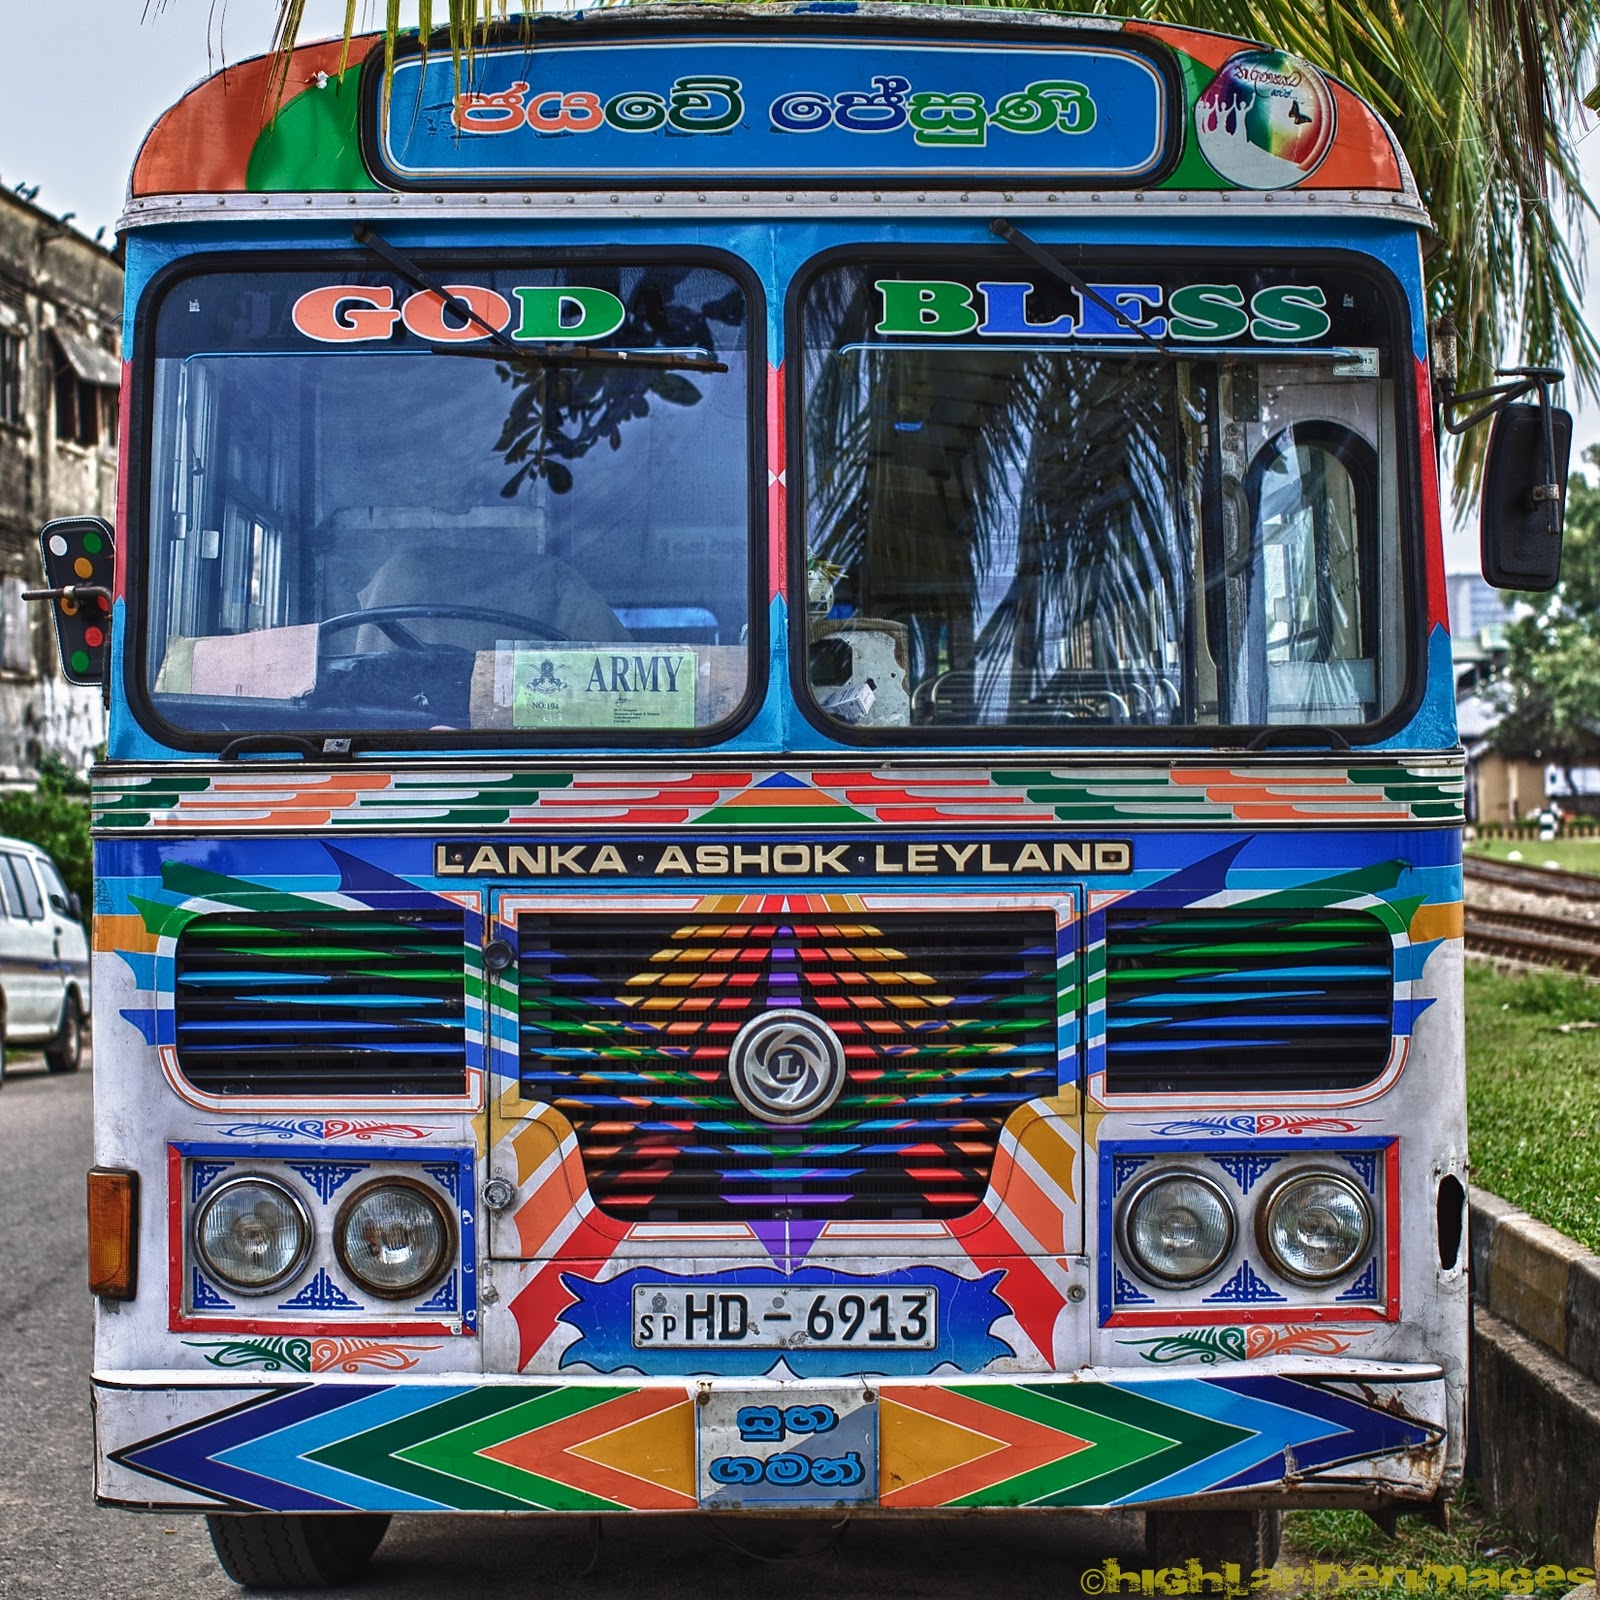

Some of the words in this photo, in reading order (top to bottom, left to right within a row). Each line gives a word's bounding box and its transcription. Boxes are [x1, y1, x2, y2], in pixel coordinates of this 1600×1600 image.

[291, 285, 627, 344] GOD
[874, 279, 1332, 343] BLESS
[585, 655, 684, 693] ARMY
[437, 846, 628, 874] LANKA
[653, 845, 850, 873] ASHOK
[875, 843, 1131, 873] LEYLAND
[708, 1451, 866, 1487] ගමන්
